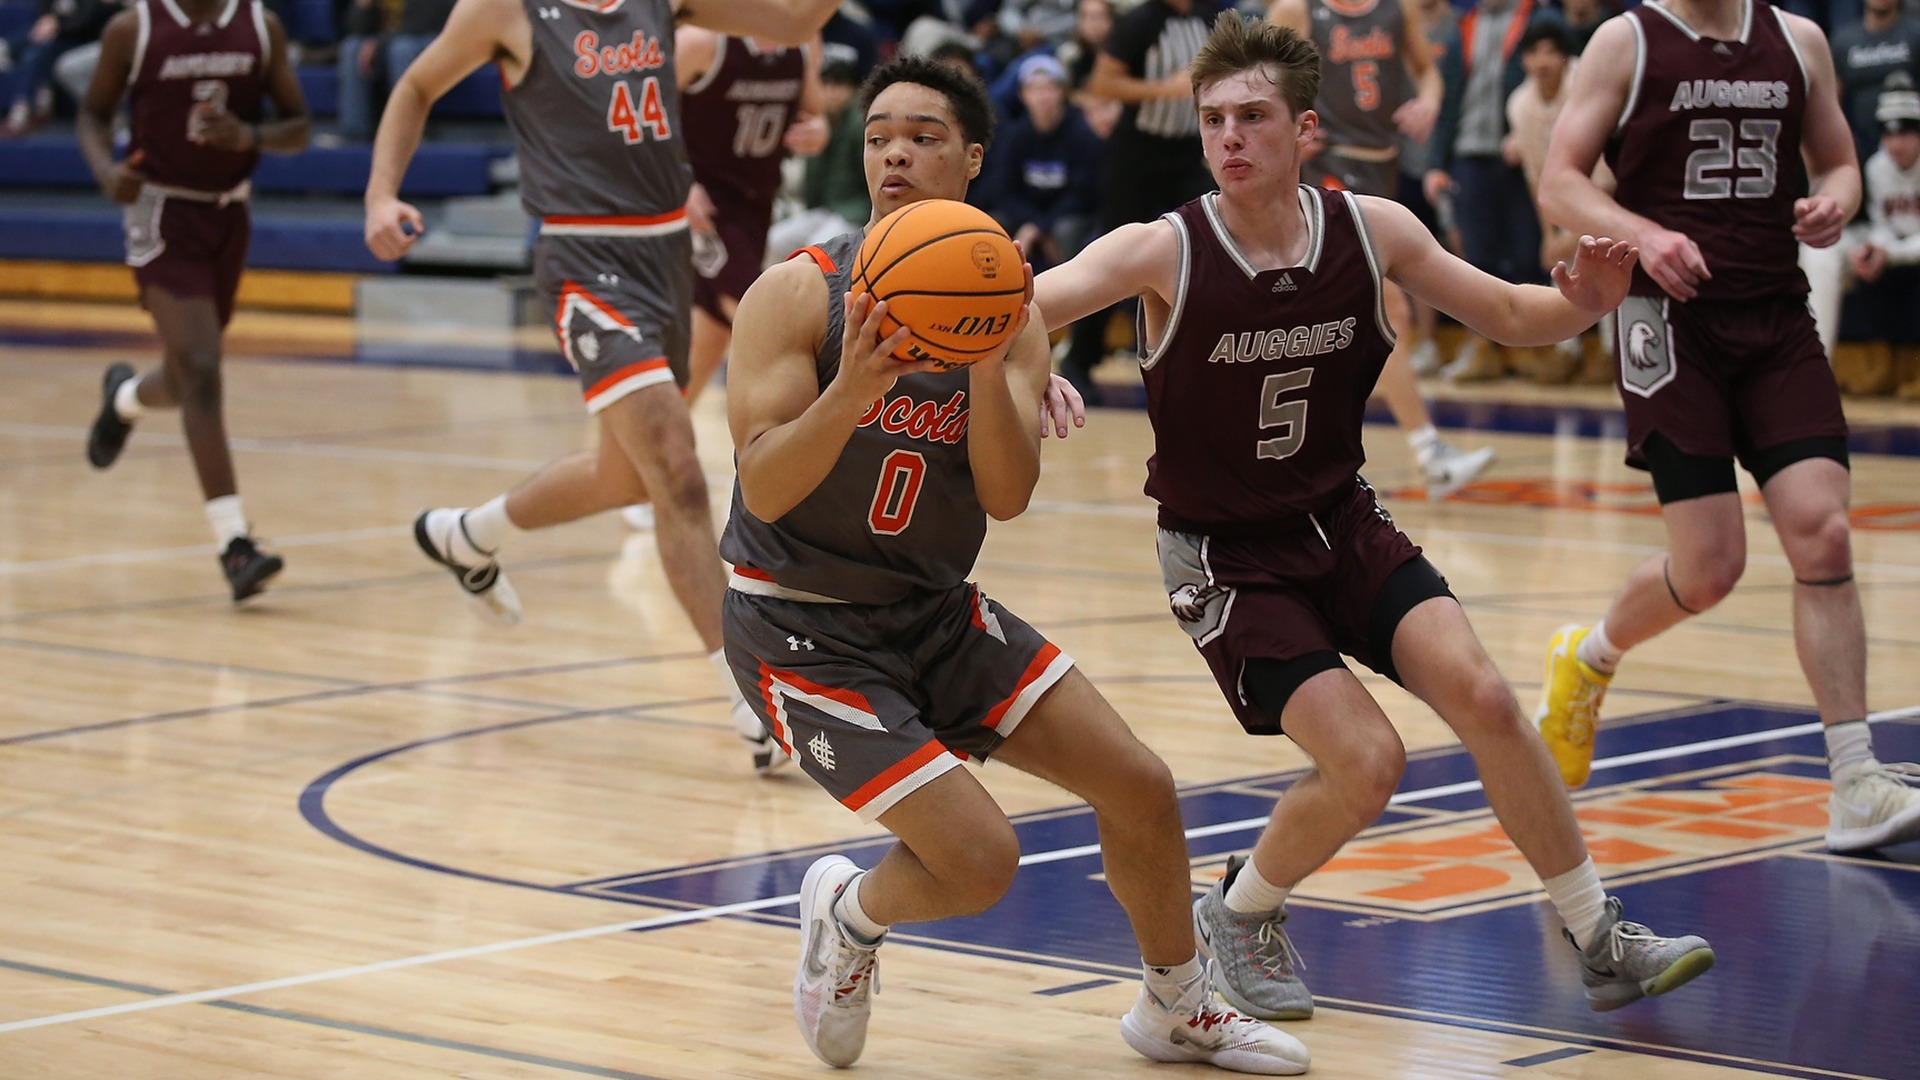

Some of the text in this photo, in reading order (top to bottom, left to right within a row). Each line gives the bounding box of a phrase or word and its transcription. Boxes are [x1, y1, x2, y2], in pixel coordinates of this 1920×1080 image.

[574, 30, 666, 78] Scots
[607, 76, 672, 145] 44
[1352, 61, 1380, 111] 5
[1669, 79, 1789, 112] AUGGIES
[732, 103, 788, 157] 10
[1683, 118, 1782, 200] 23
[1271, 284, 1298, 293] adidas
[929, 323, 952, 333] NXT
[1208, 317, 1357, 363] AUGGIES
[1257, 367, 1315, 460] 5
[867, 448, 927, 536] 0
